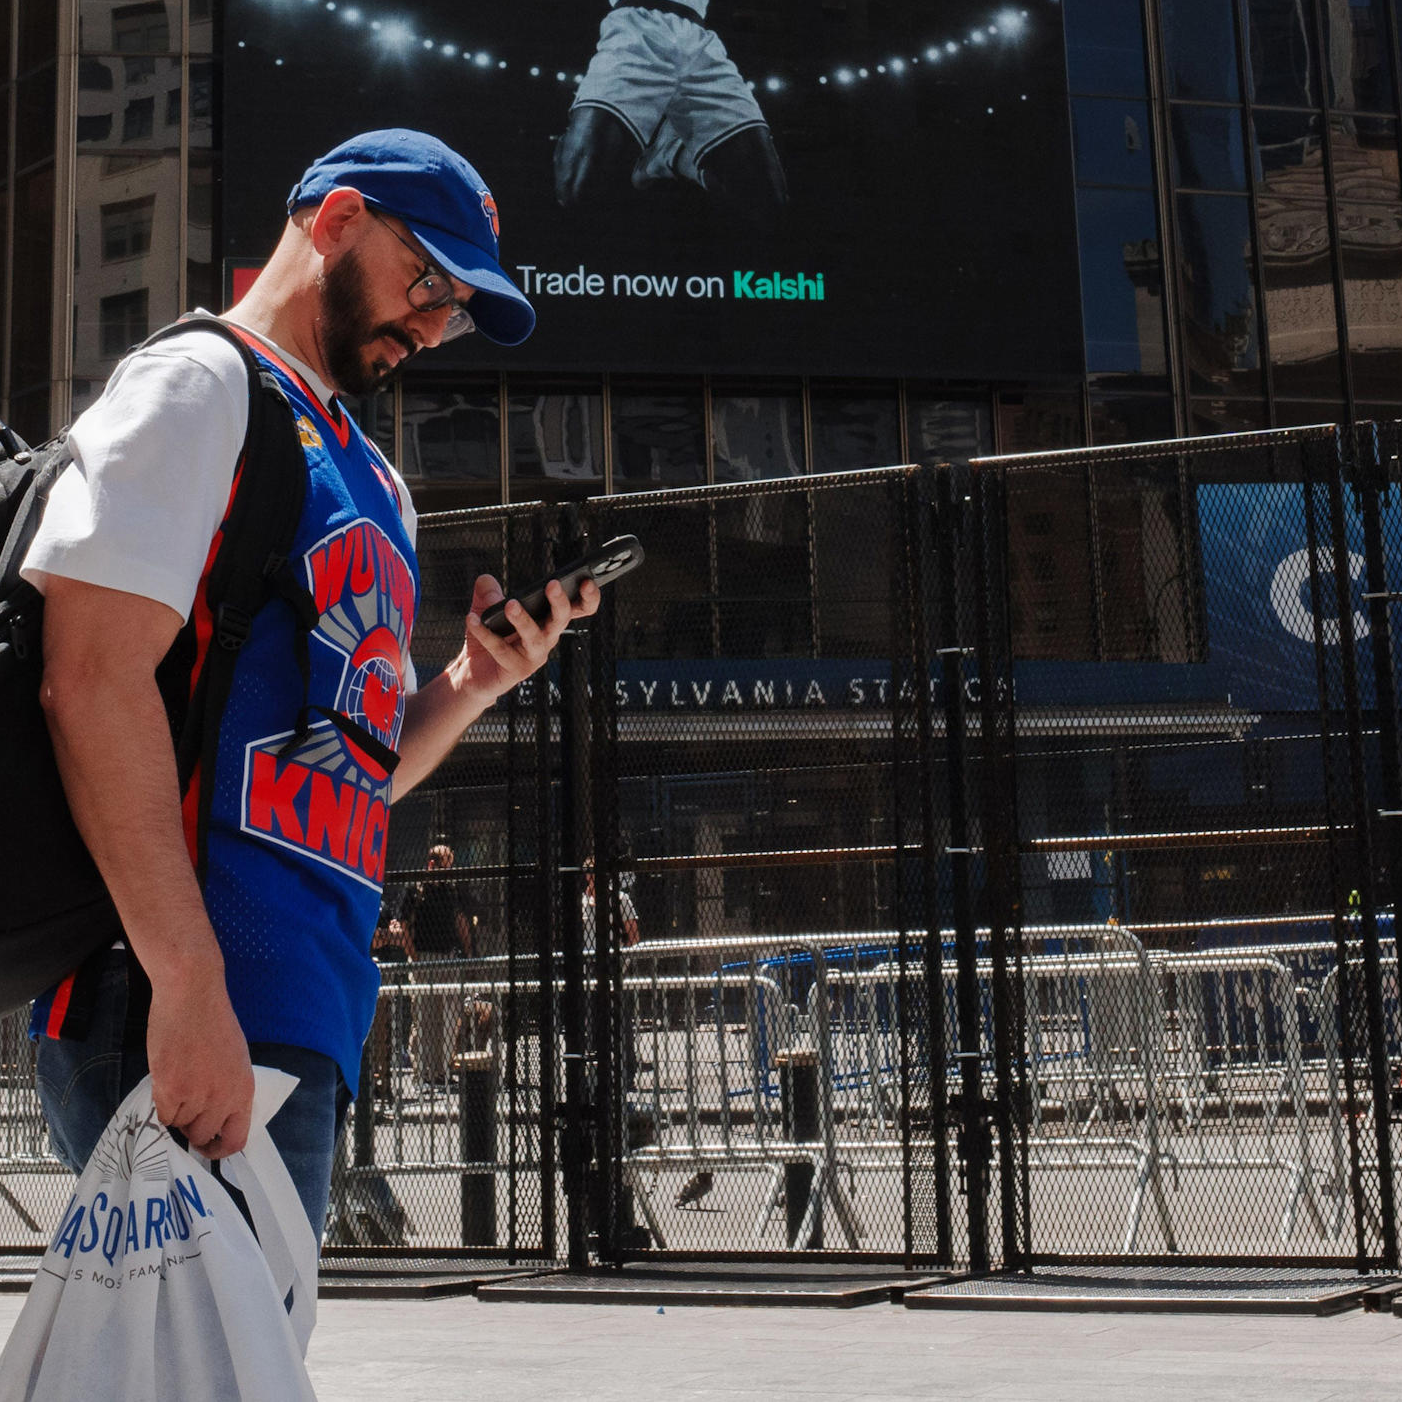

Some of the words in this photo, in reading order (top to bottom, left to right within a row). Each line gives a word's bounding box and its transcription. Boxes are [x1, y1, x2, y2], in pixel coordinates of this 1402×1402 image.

[516, 265, 605, 296] Trade
[612, 274, 679, 298] now
[685, 276, 725, 299] on
[733, 270, 825, 301] Kalshi
[311, 523, 376, 616] WU
